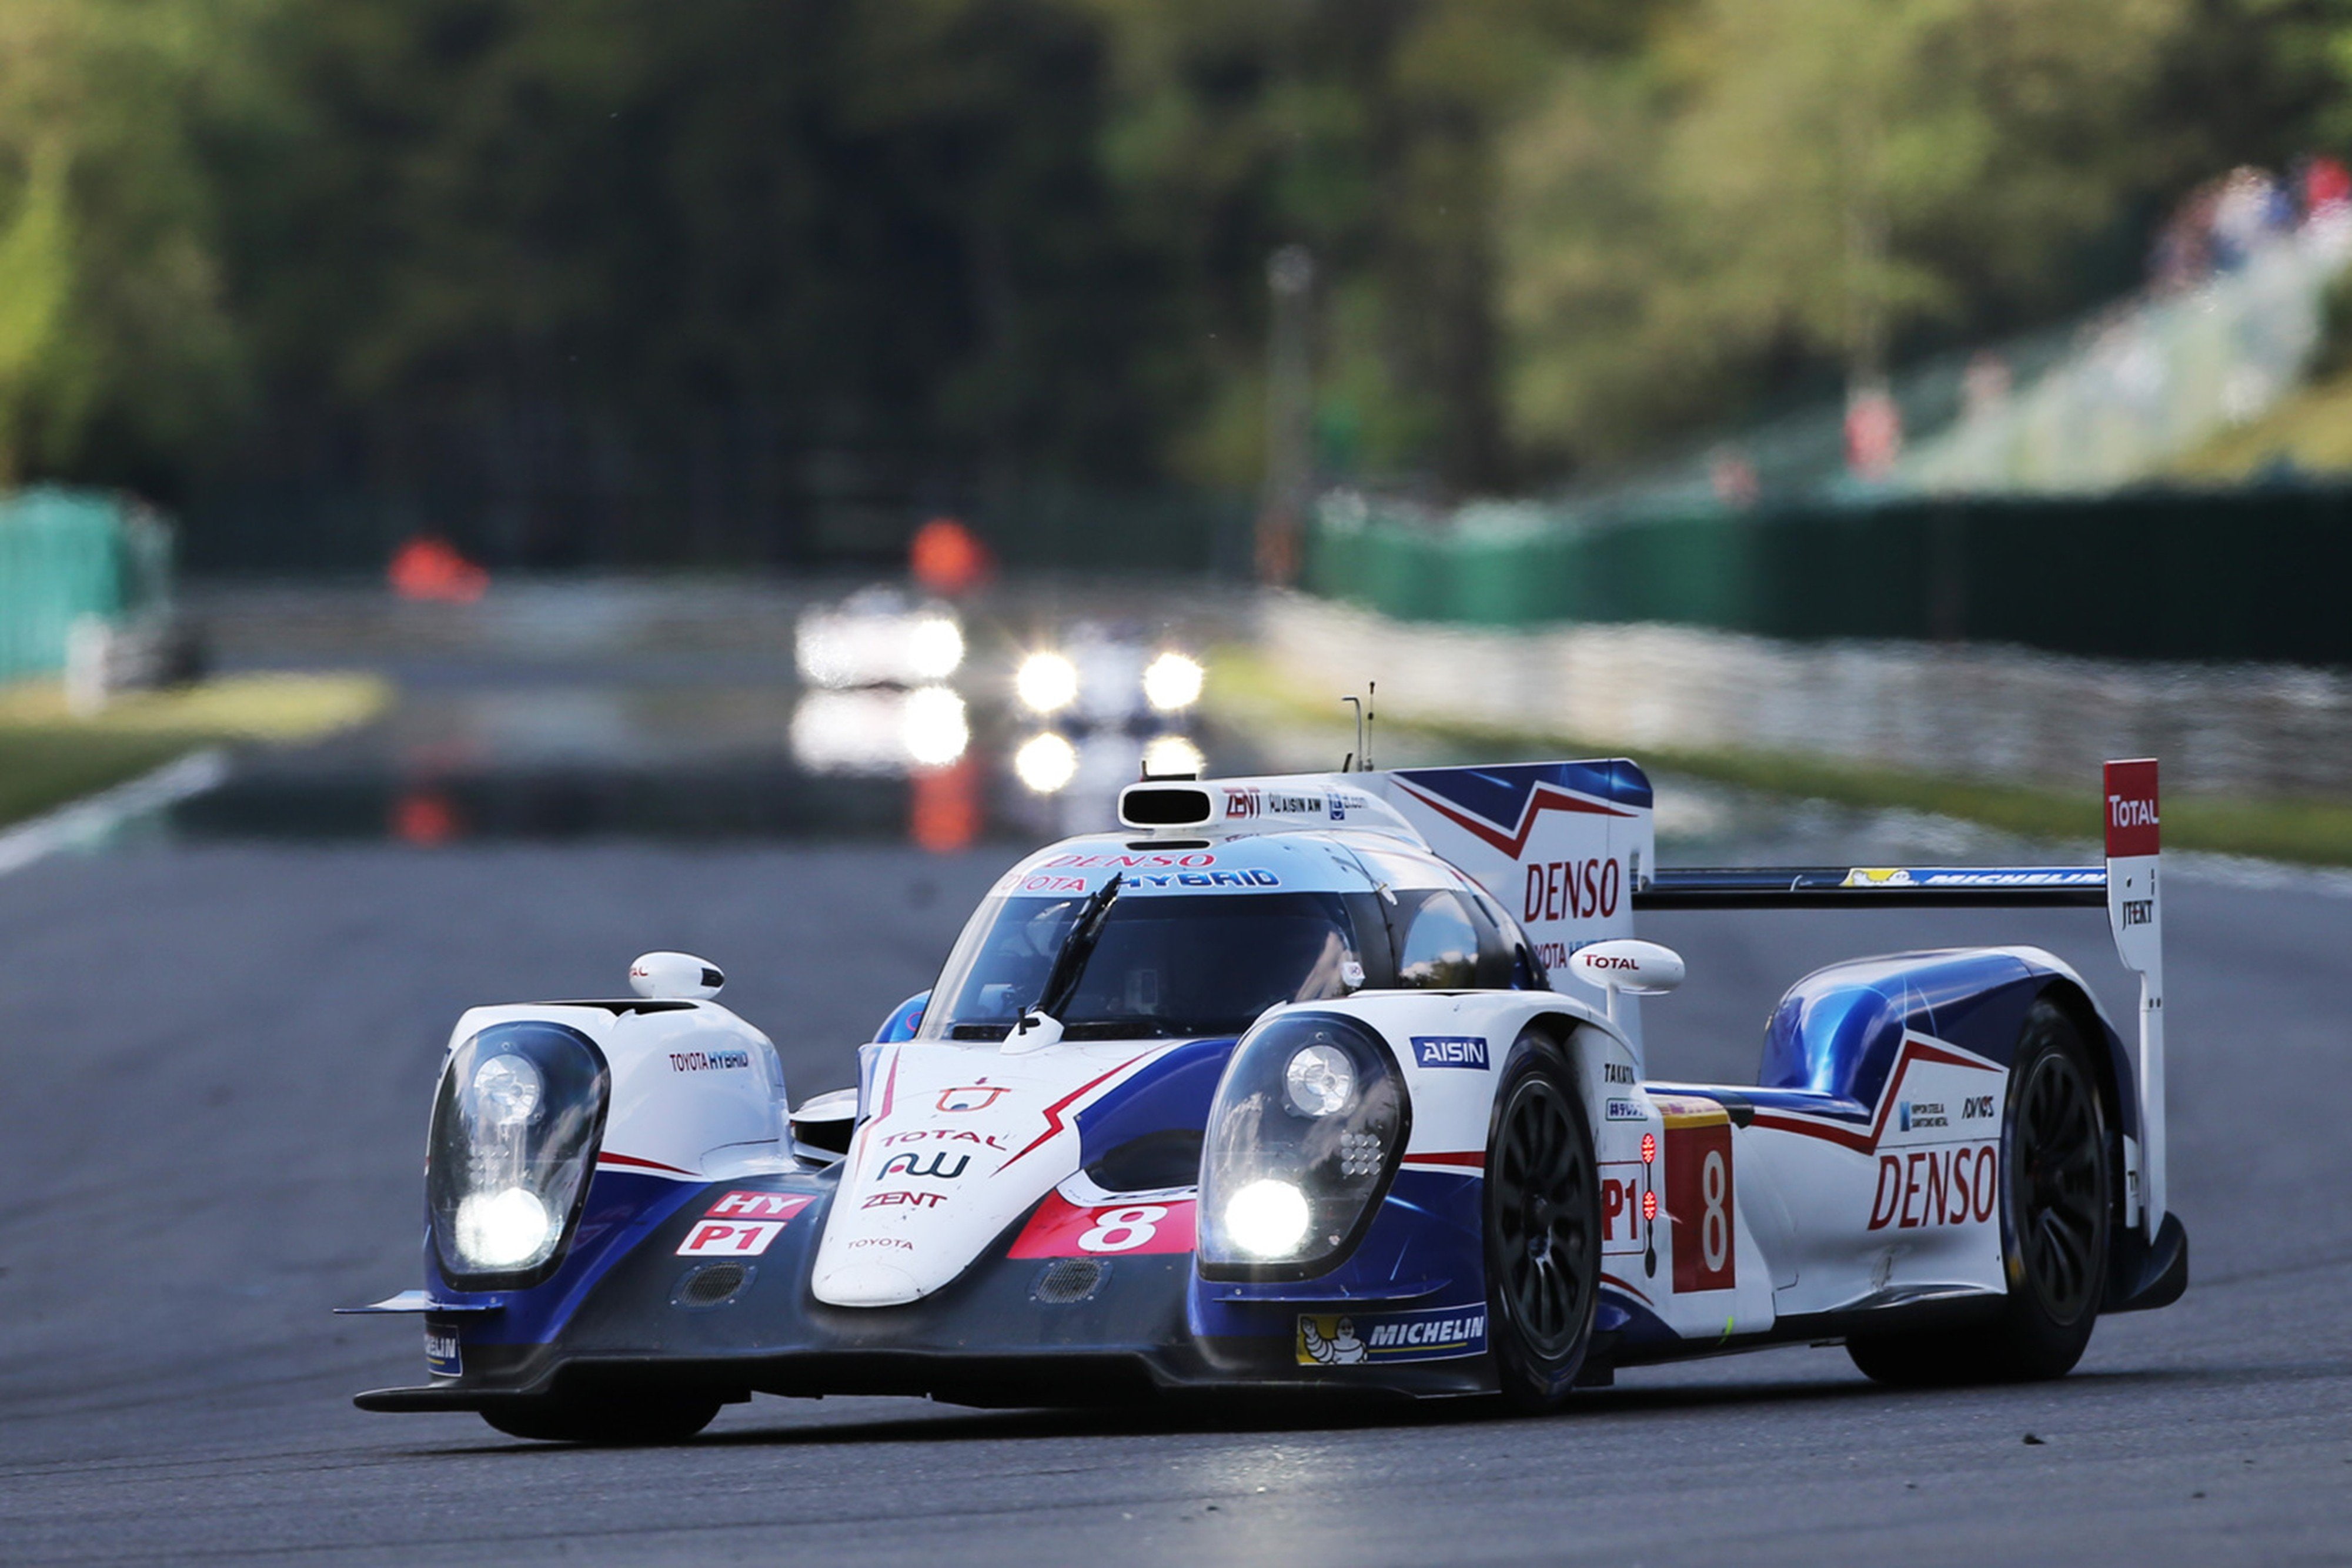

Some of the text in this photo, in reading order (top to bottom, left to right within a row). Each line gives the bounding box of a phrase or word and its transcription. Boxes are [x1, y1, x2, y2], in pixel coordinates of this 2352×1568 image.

[1222, 787, 1261, 818] ZENT
[1282, 797, 1305, 813] AISIN
[2109, 795, 2159, 827] TOTAL
[1044, 854, 1216, 868] DENSO
[1108, 868, 1280, 888] HYBRID
[1925, 874, 2107, 883] MICHELIN
[1524, 857, 1619, 923] DENSO
[2122, 899, 2153, 931] JTEKT
[1583, 954, 1640, 970] TOTAL
[669, 1050, 749, 1072] TOYOTA HYBRID
[1422, 1041, 1485, 1063] AISIN
[882, 1129, 1007, 1151] TOTAL
[1867, 1145, 1996, 1231] DENSO
[713, 1194, 809, 1215] HY
[860, 1191, 948, 1211] ZENT
[1602, 1178, 1638, 1241] P1
[1701, 1150, 1727, 1273] 8
[689, 1226, 764, 1250] P1
[1077, 1205, 1169, 1253] 8
[847, 1238, 914, 1251] TOYOTA
[1369, 1315, 1485, 1346] MICHELIN
